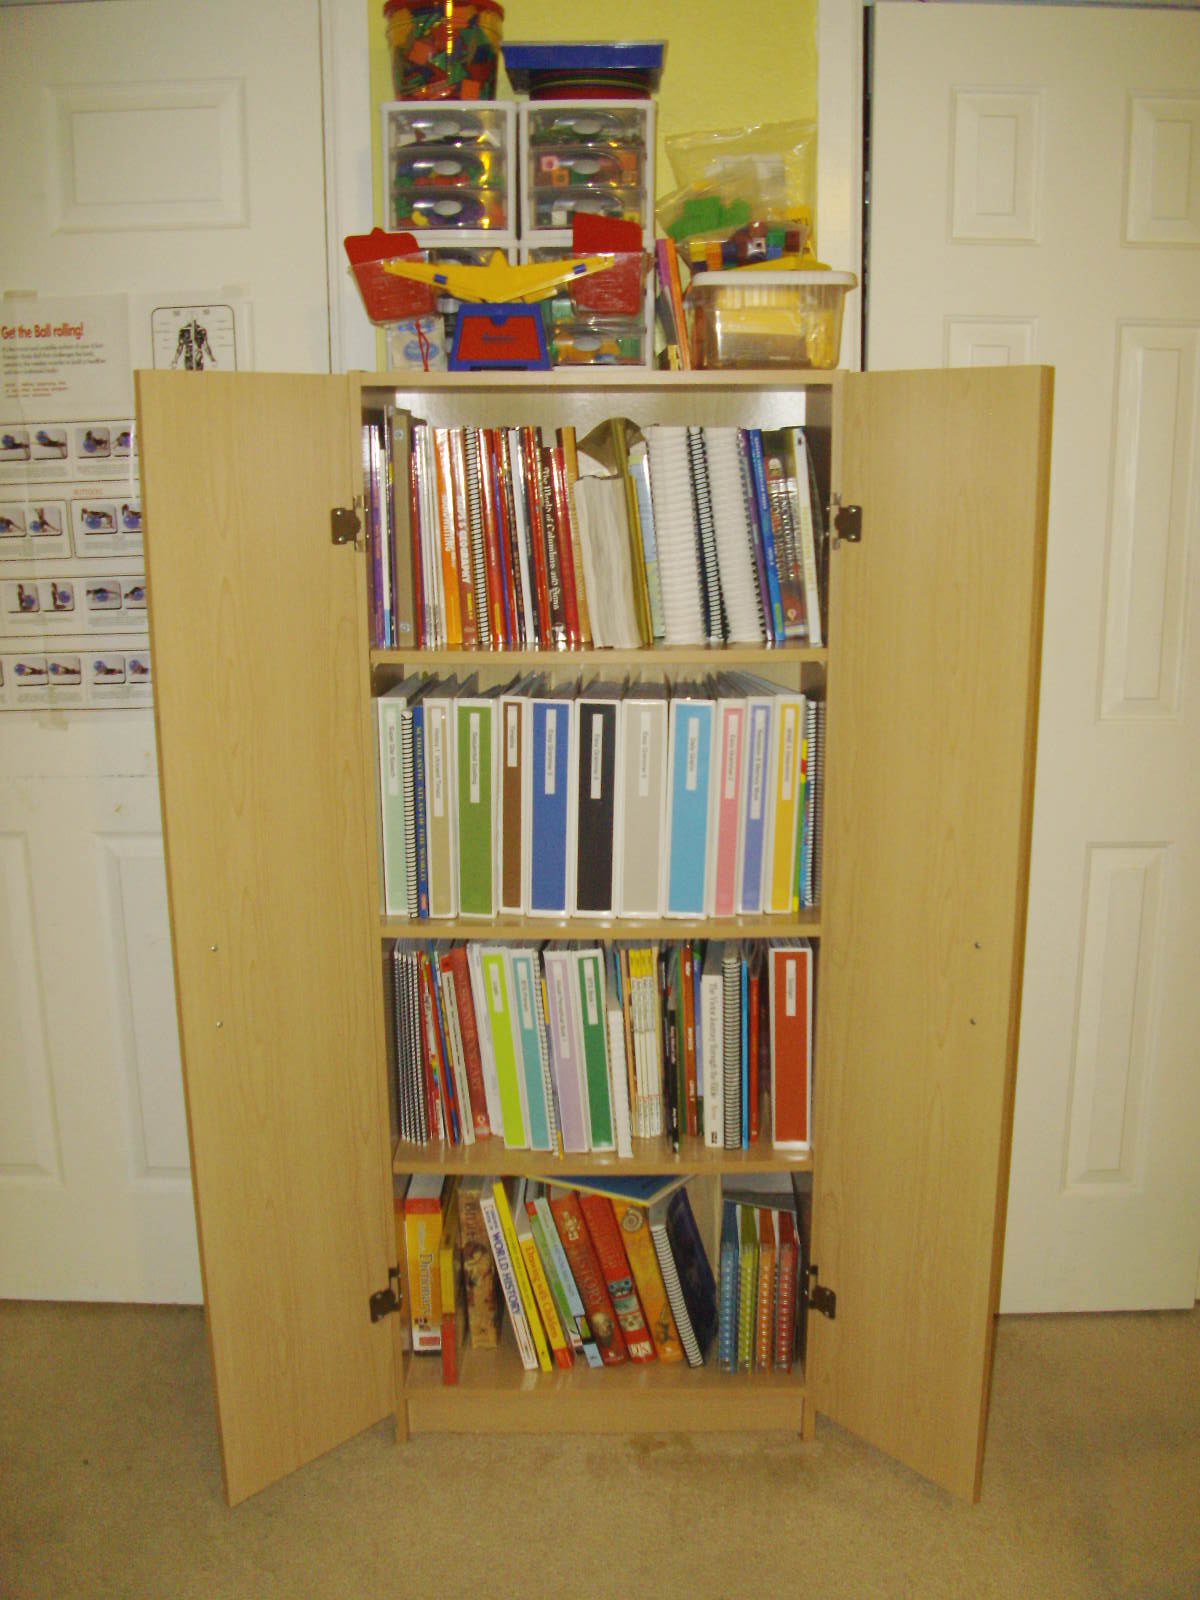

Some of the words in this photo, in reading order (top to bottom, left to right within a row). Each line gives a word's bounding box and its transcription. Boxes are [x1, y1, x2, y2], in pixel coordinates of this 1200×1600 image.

[2, 326, 16, 339] Get
[18, 325, 32, 338] the
[34, 323, 51, 338] Ball
[53, 321, 84, 340] rolling!
[543, 467, 552, 484] The
[544, 485, 553, 512] World
[779, 493, 794, 562] ENCYCLOPEDIA
[458, 530, 471, 585] GEOGRAPHY
[546, 523, 556, 570] Columbus
[550, 570, 558, 586] and
[416, 786, 424, 817] ATLAS
[418, 848, 426, 881] WORLD
[709, 983, 718, 995] The
[707, 1017, 718, 1042] Journey
[492, 1231, 509, 1271] WORLD
[503, 1272, 521, 1315] HISTORY
[526, 1245, 541, 1281] Drawing
